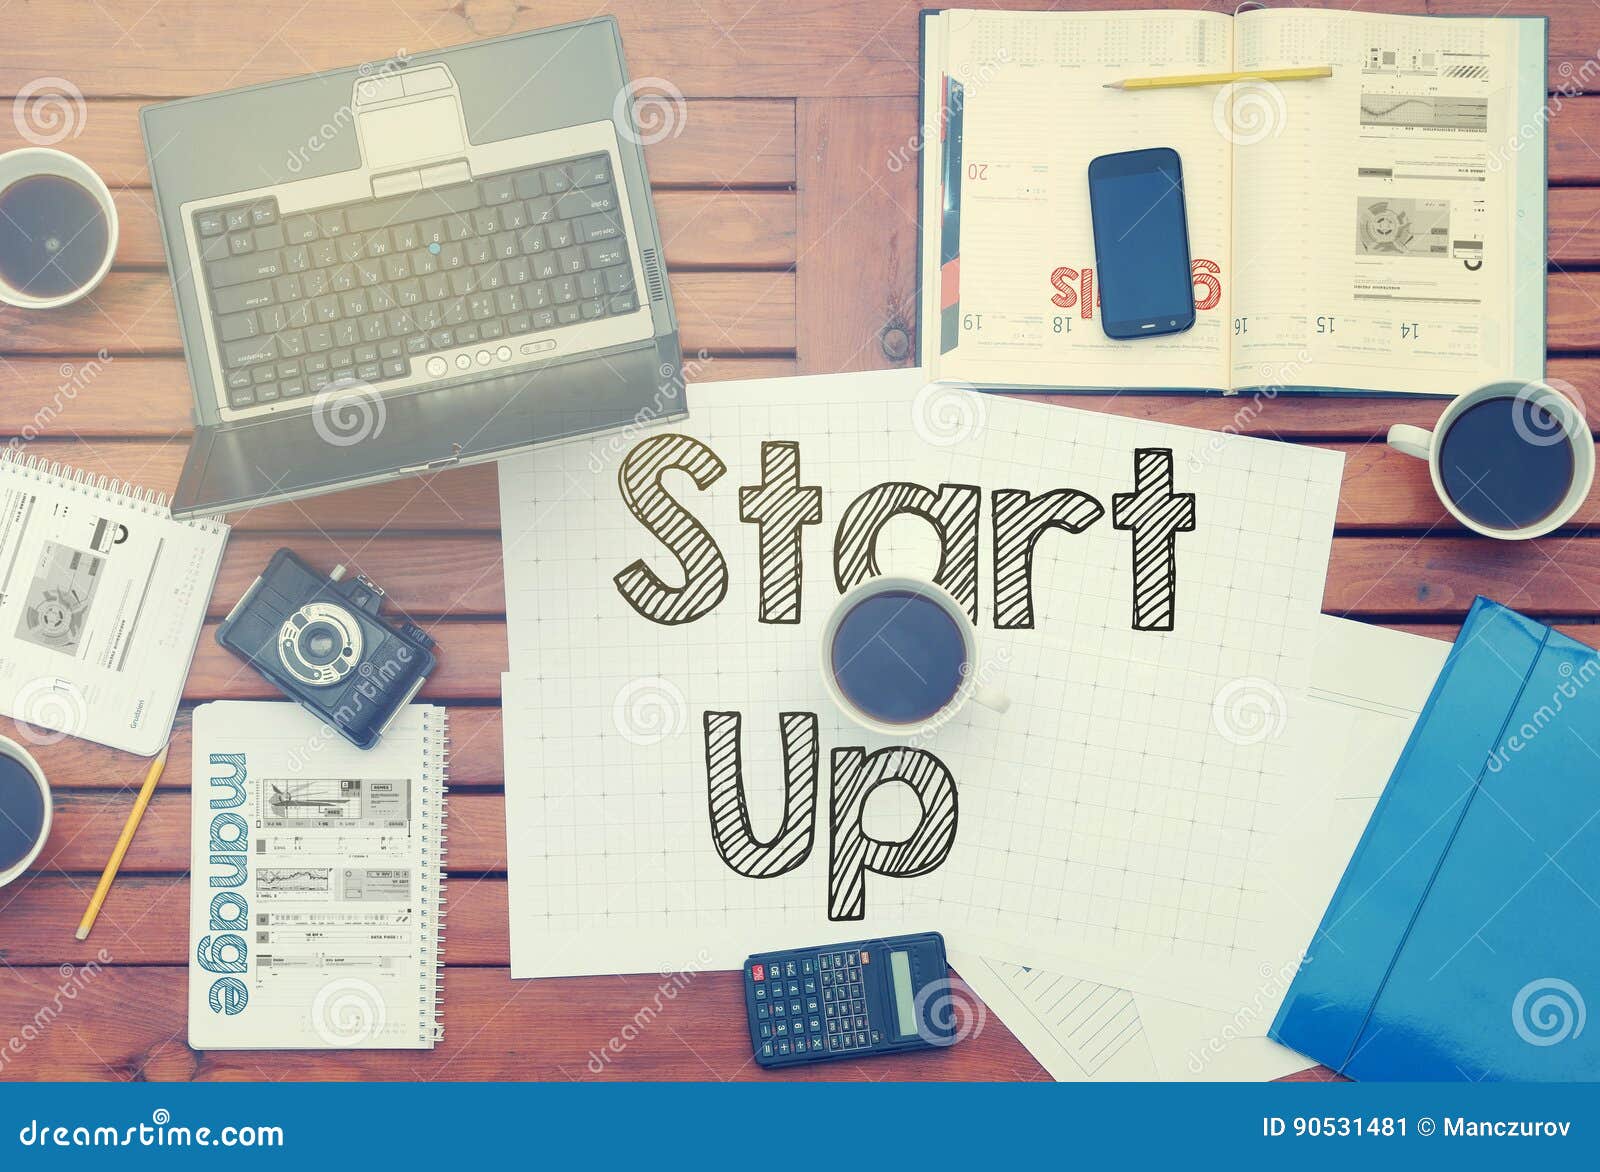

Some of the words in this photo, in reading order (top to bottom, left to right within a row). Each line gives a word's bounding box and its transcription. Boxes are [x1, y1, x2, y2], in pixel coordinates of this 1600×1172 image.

[968, 163, 988, 180] 20
[963, 314, 982, 330] 19
[1053, 316, 1072, 333] 18
[1234, 318, 1248, 336] 16
[1317, 317, 1335, 333] 15
[1400, 323, 1419, 339] 14
[613, 433, 1196, 631] Start
[198, 753, 249, 1016] manage
